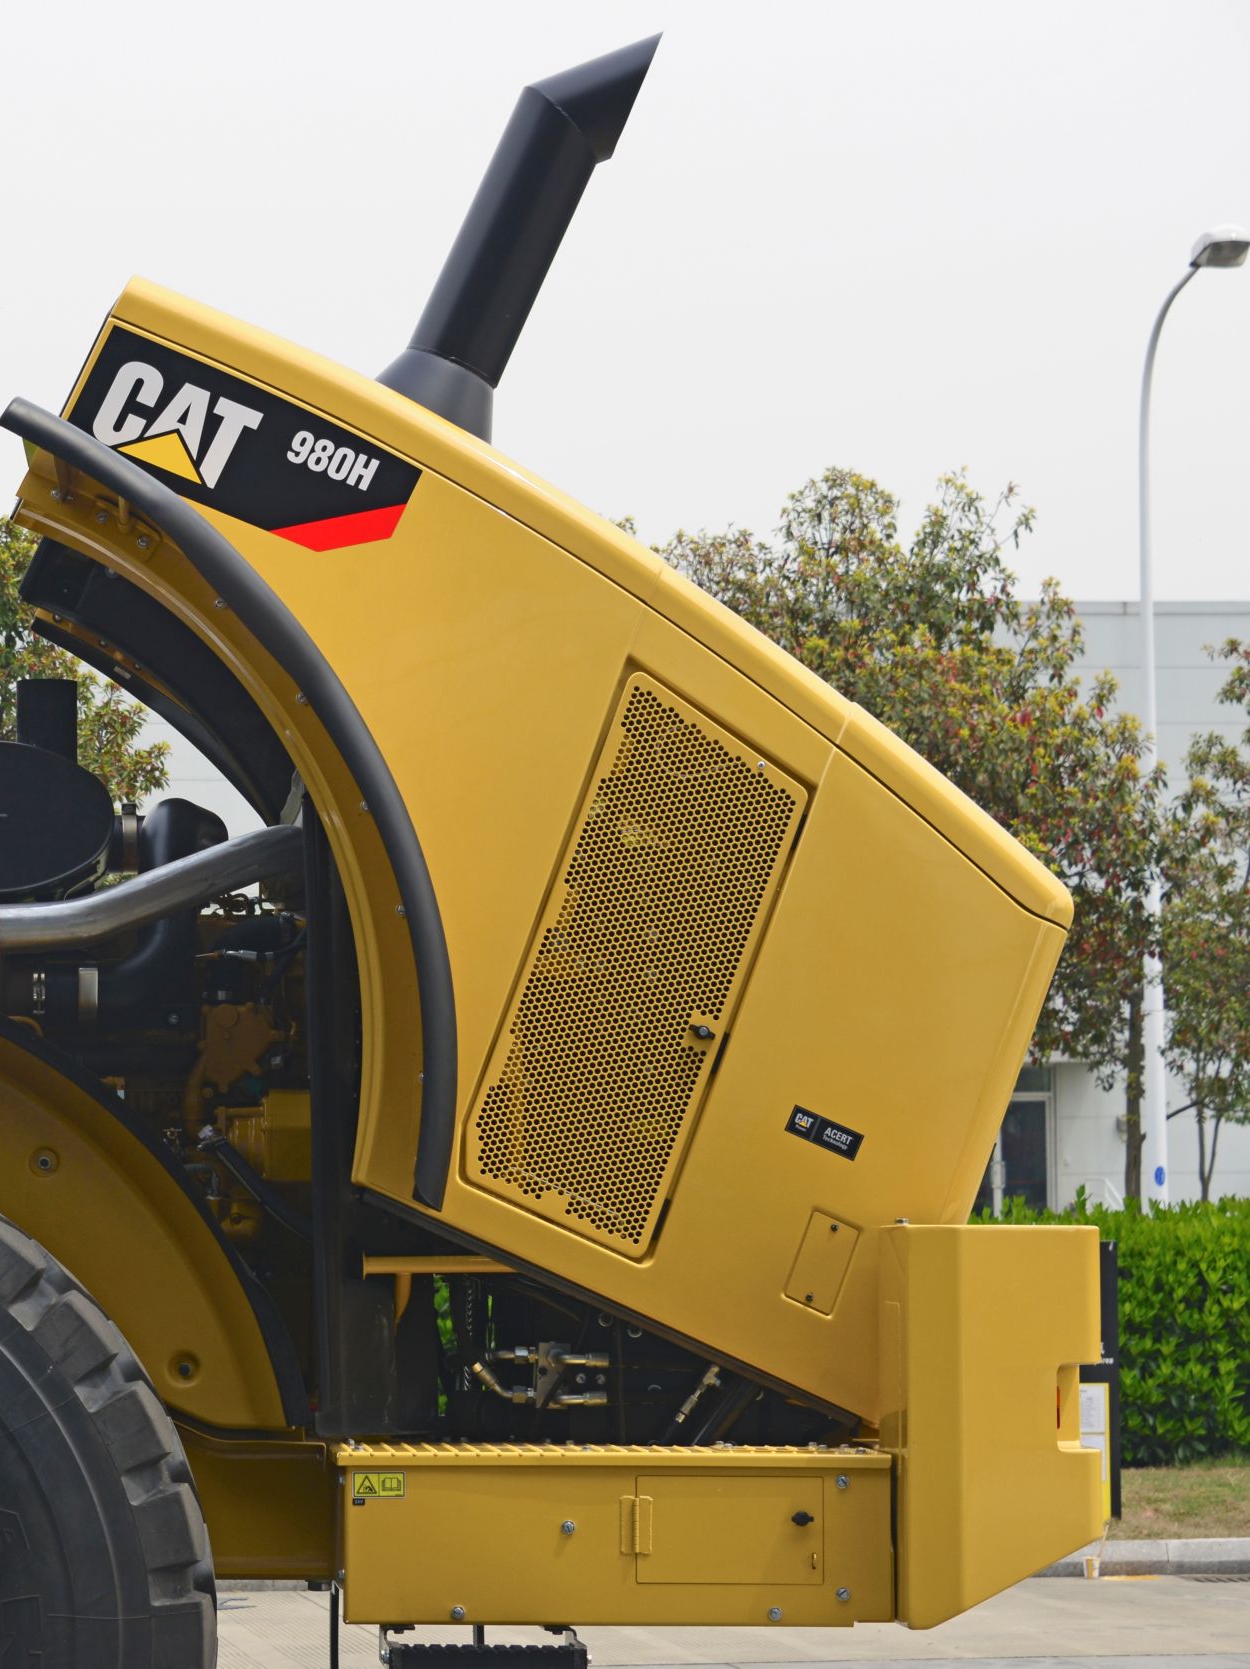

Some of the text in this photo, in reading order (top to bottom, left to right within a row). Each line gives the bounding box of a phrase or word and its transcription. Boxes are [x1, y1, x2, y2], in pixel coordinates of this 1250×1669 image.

[92, 361, 264, 489] CAT
[287, 431, 380, 490] 980H
[795, 1113, 814, 1128] CAT
[822, 1134, 848, 1151] Technology
[824, 1127, 853, 1144] ACERT
